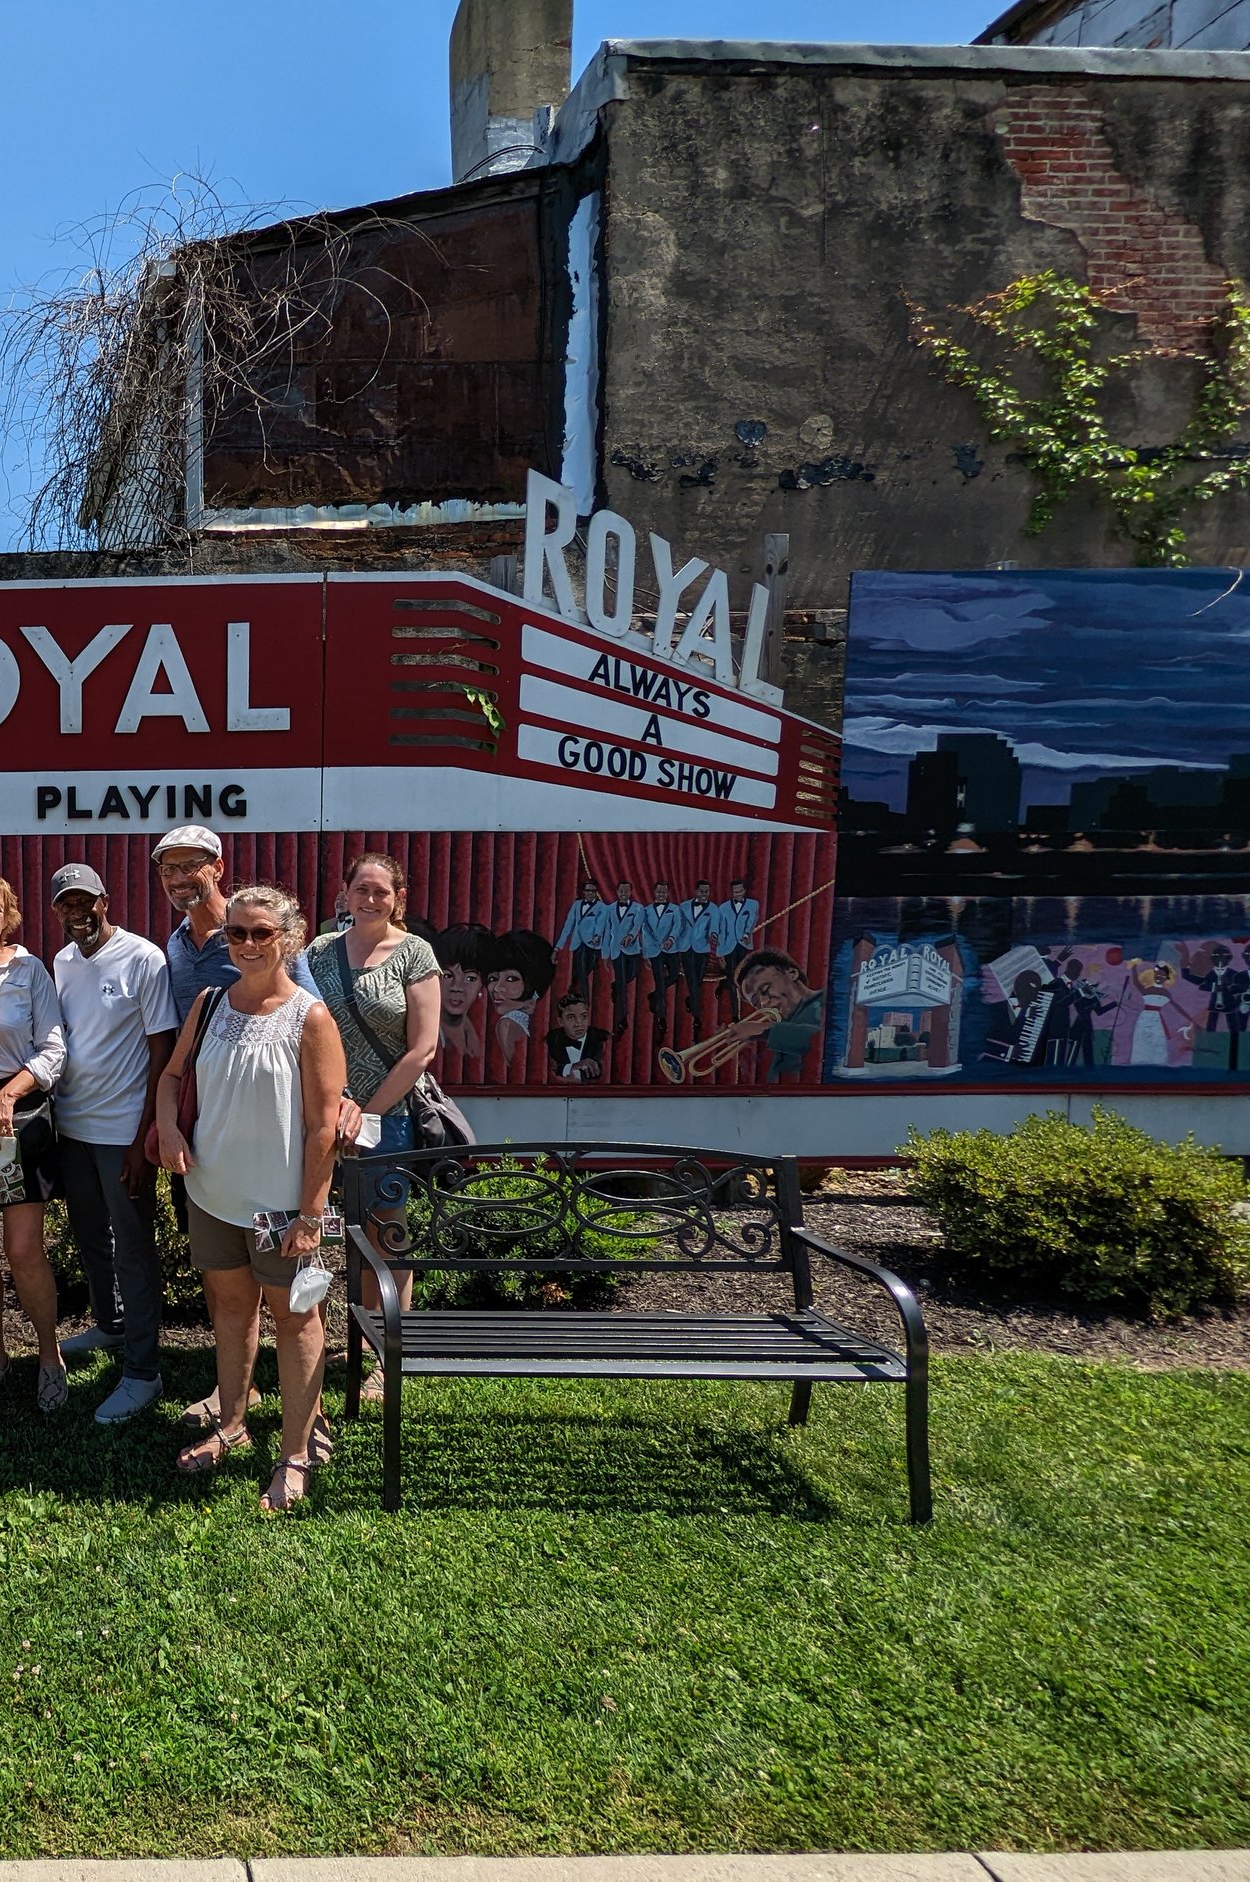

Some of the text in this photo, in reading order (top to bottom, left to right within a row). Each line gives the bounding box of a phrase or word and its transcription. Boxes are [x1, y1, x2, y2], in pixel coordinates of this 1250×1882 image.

[524, 468, 784, 708] ROYAL
[588, 654, 711, 719] ALWAYS
[641, 714, 662, 745] A
[558, 735, 737, 800] GOOD SHOW
[37, 784, 248, 819] PLAYING
[860, 947, 907, 973] ROYAL
[923, 946, 951, 973] ROYAL
